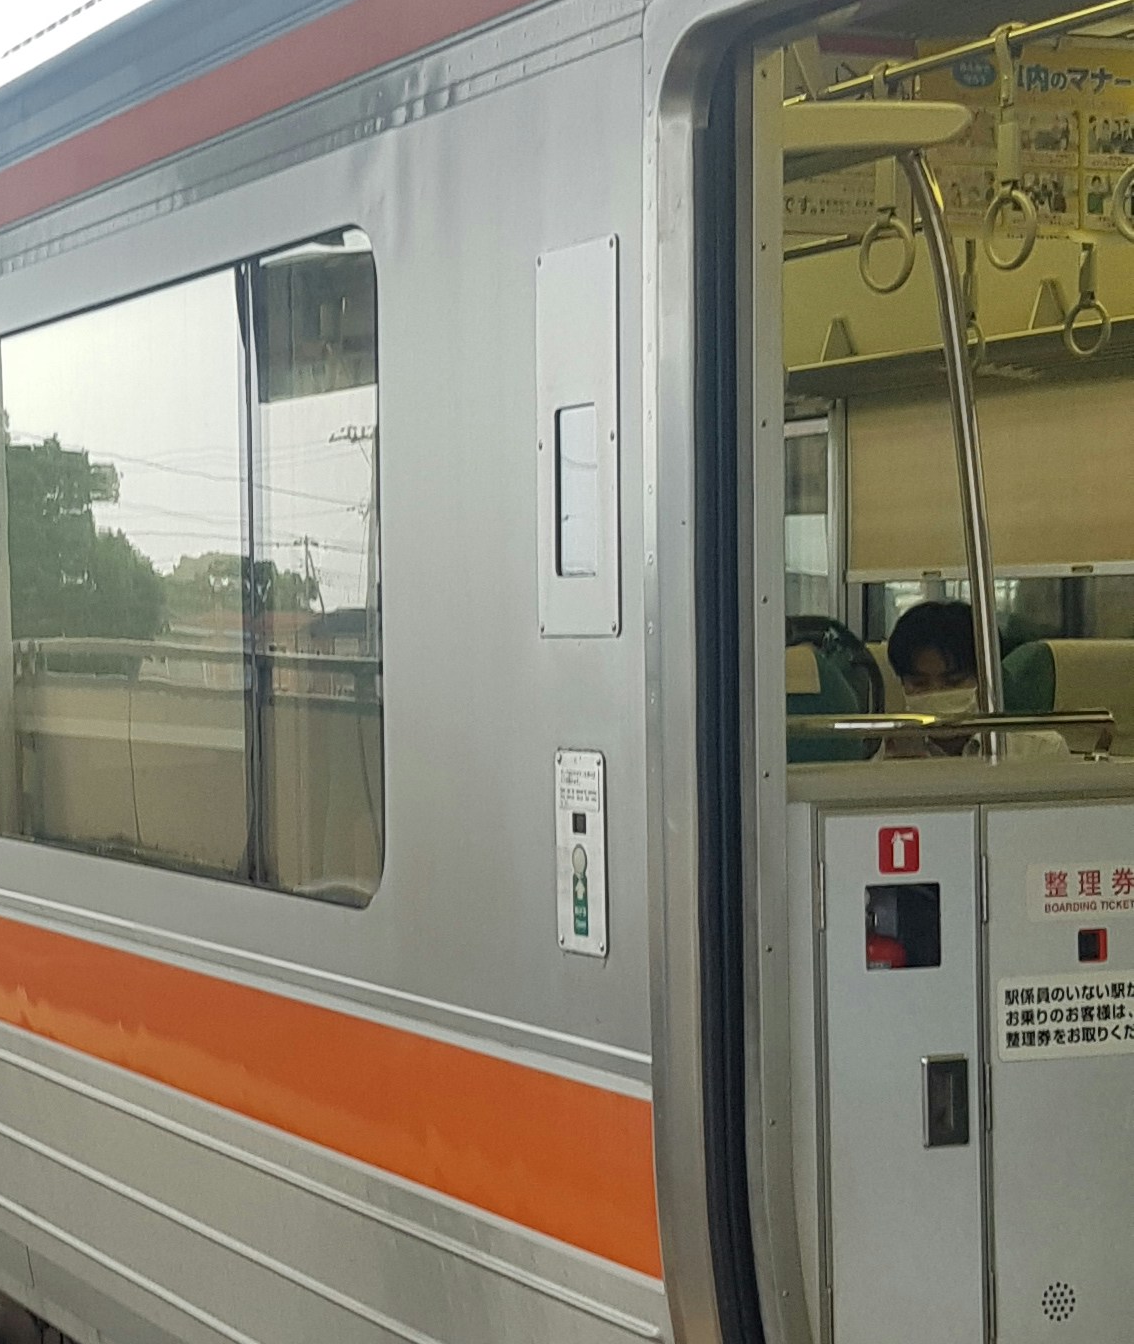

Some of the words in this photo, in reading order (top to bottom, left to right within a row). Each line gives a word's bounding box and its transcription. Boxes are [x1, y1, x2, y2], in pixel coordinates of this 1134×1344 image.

[1017, 64, 1133, 93] 内のマナー
[1044, 867, 1134, 898] 整理券
[1044, 900, 1097, 914] BOARDING
